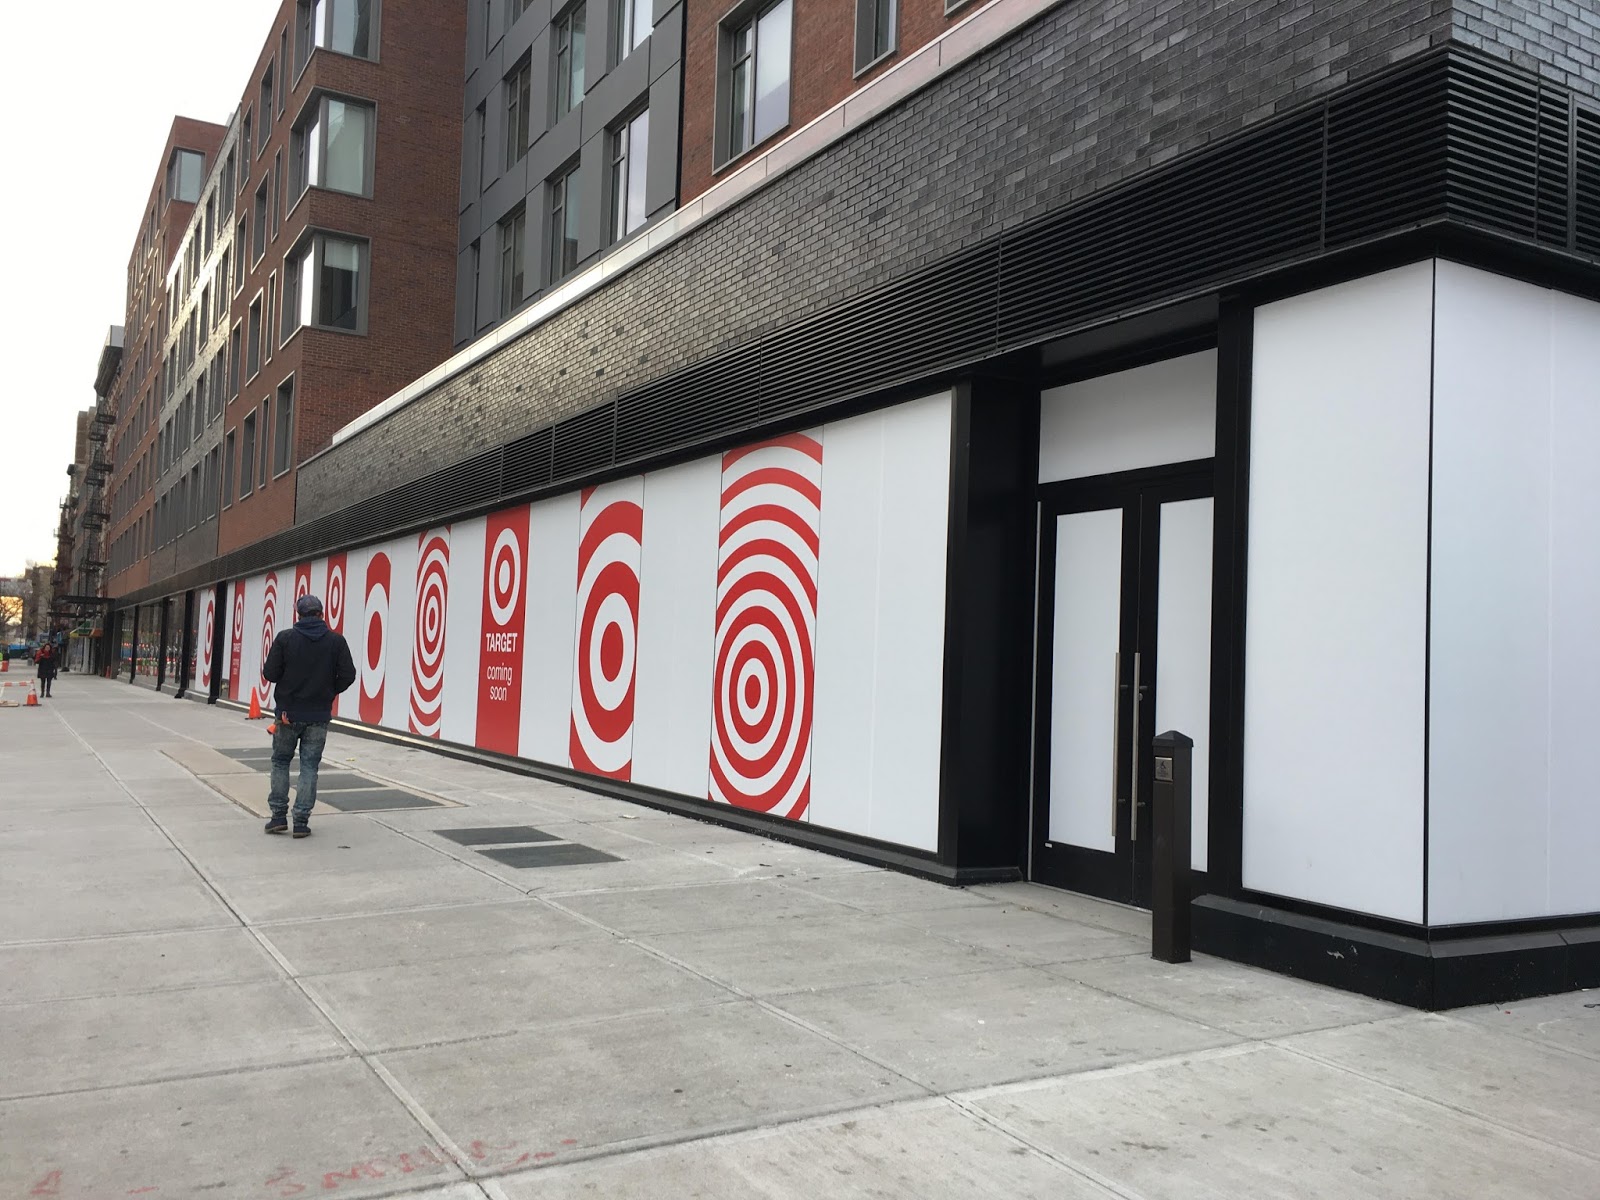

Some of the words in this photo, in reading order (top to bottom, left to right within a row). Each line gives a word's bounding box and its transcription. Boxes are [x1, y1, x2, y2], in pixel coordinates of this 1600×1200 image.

[486, 632, 518, 653] TARGET
[486, 662, 513, 686] coming
[489, 686, 507, 701] soon
